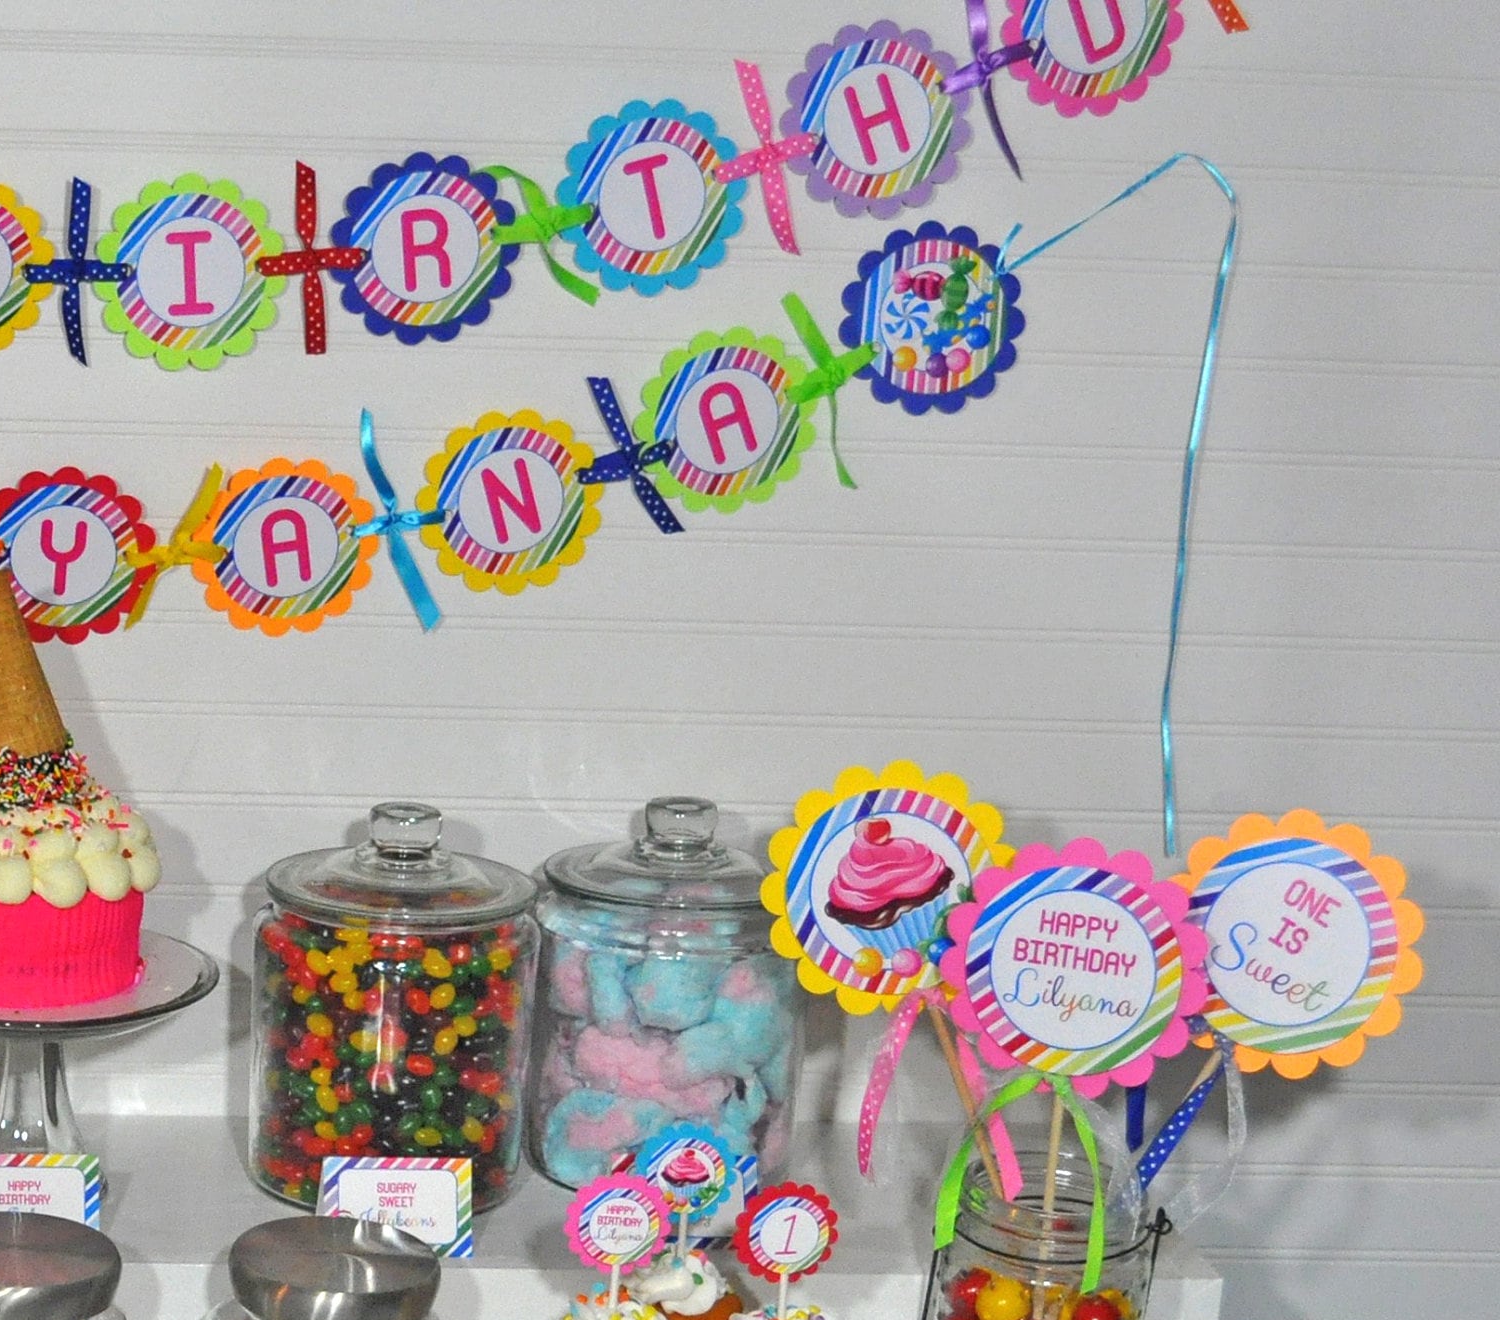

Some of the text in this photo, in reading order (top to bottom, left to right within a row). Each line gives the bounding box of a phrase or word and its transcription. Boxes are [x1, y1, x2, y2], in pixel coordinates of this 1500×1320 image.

[1283, 878, 1343, 929] ONE
[1038, 908, 1119, 940] HAPPY
[1267, 920, 1305, 954] IS
[1012, 938, 1137, 977] BIRTHDAY
[1210, 922, 1331, 1013] Sweet
[1002, 967, 1138, 1020] Lilyana
[7, 1181, 41, 1191] HAPPY
[376, 1182, 417, 1194] SUGARY
[379, 1196, 414, 1208] SWEET
[597, 1215, 643, 1228] BIRTHDAY
[606, 1205, 636, 1216] HAPPY
[774, 1214, 798, 1255] 1
